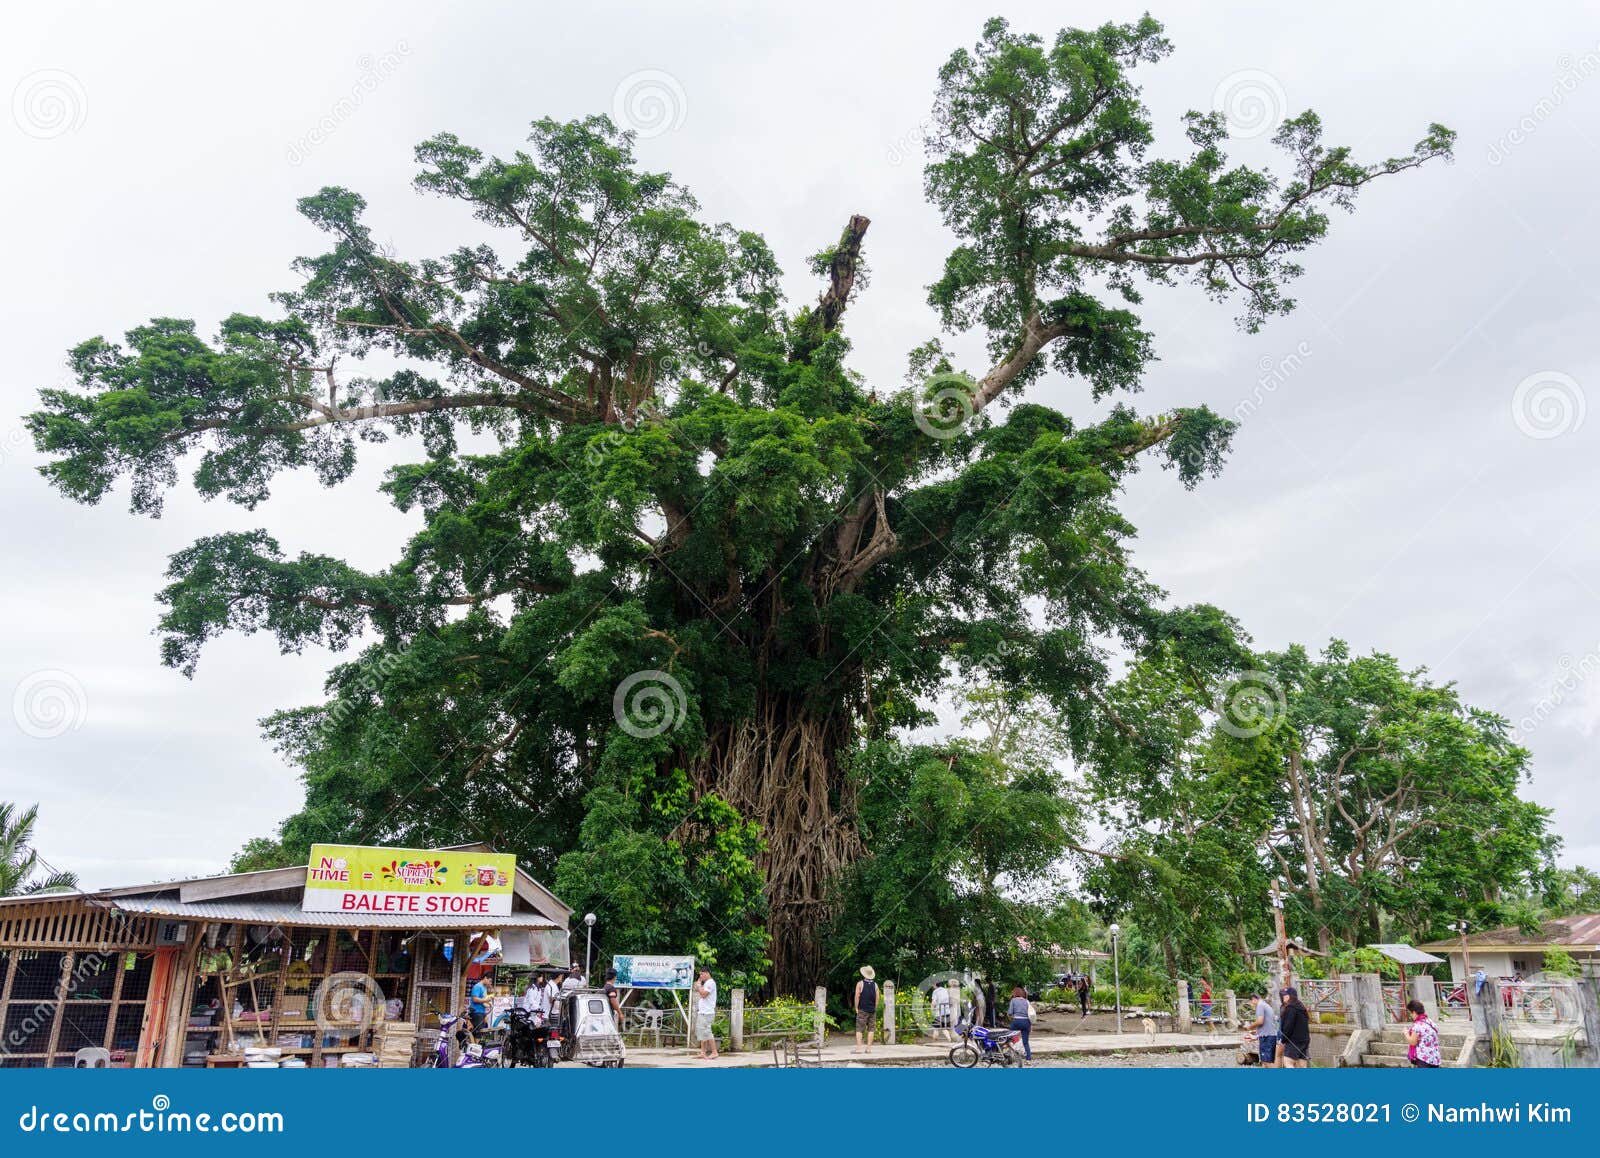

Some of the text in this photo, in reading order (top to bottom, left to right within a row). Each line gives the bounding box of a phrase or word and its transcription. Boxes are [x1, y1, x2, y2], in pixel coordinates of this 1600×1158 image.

[310, 869, 350, 881] TIME
[403, 877, 425, 885] TIME
[342, 894, 490, 912] BALETE STORE
